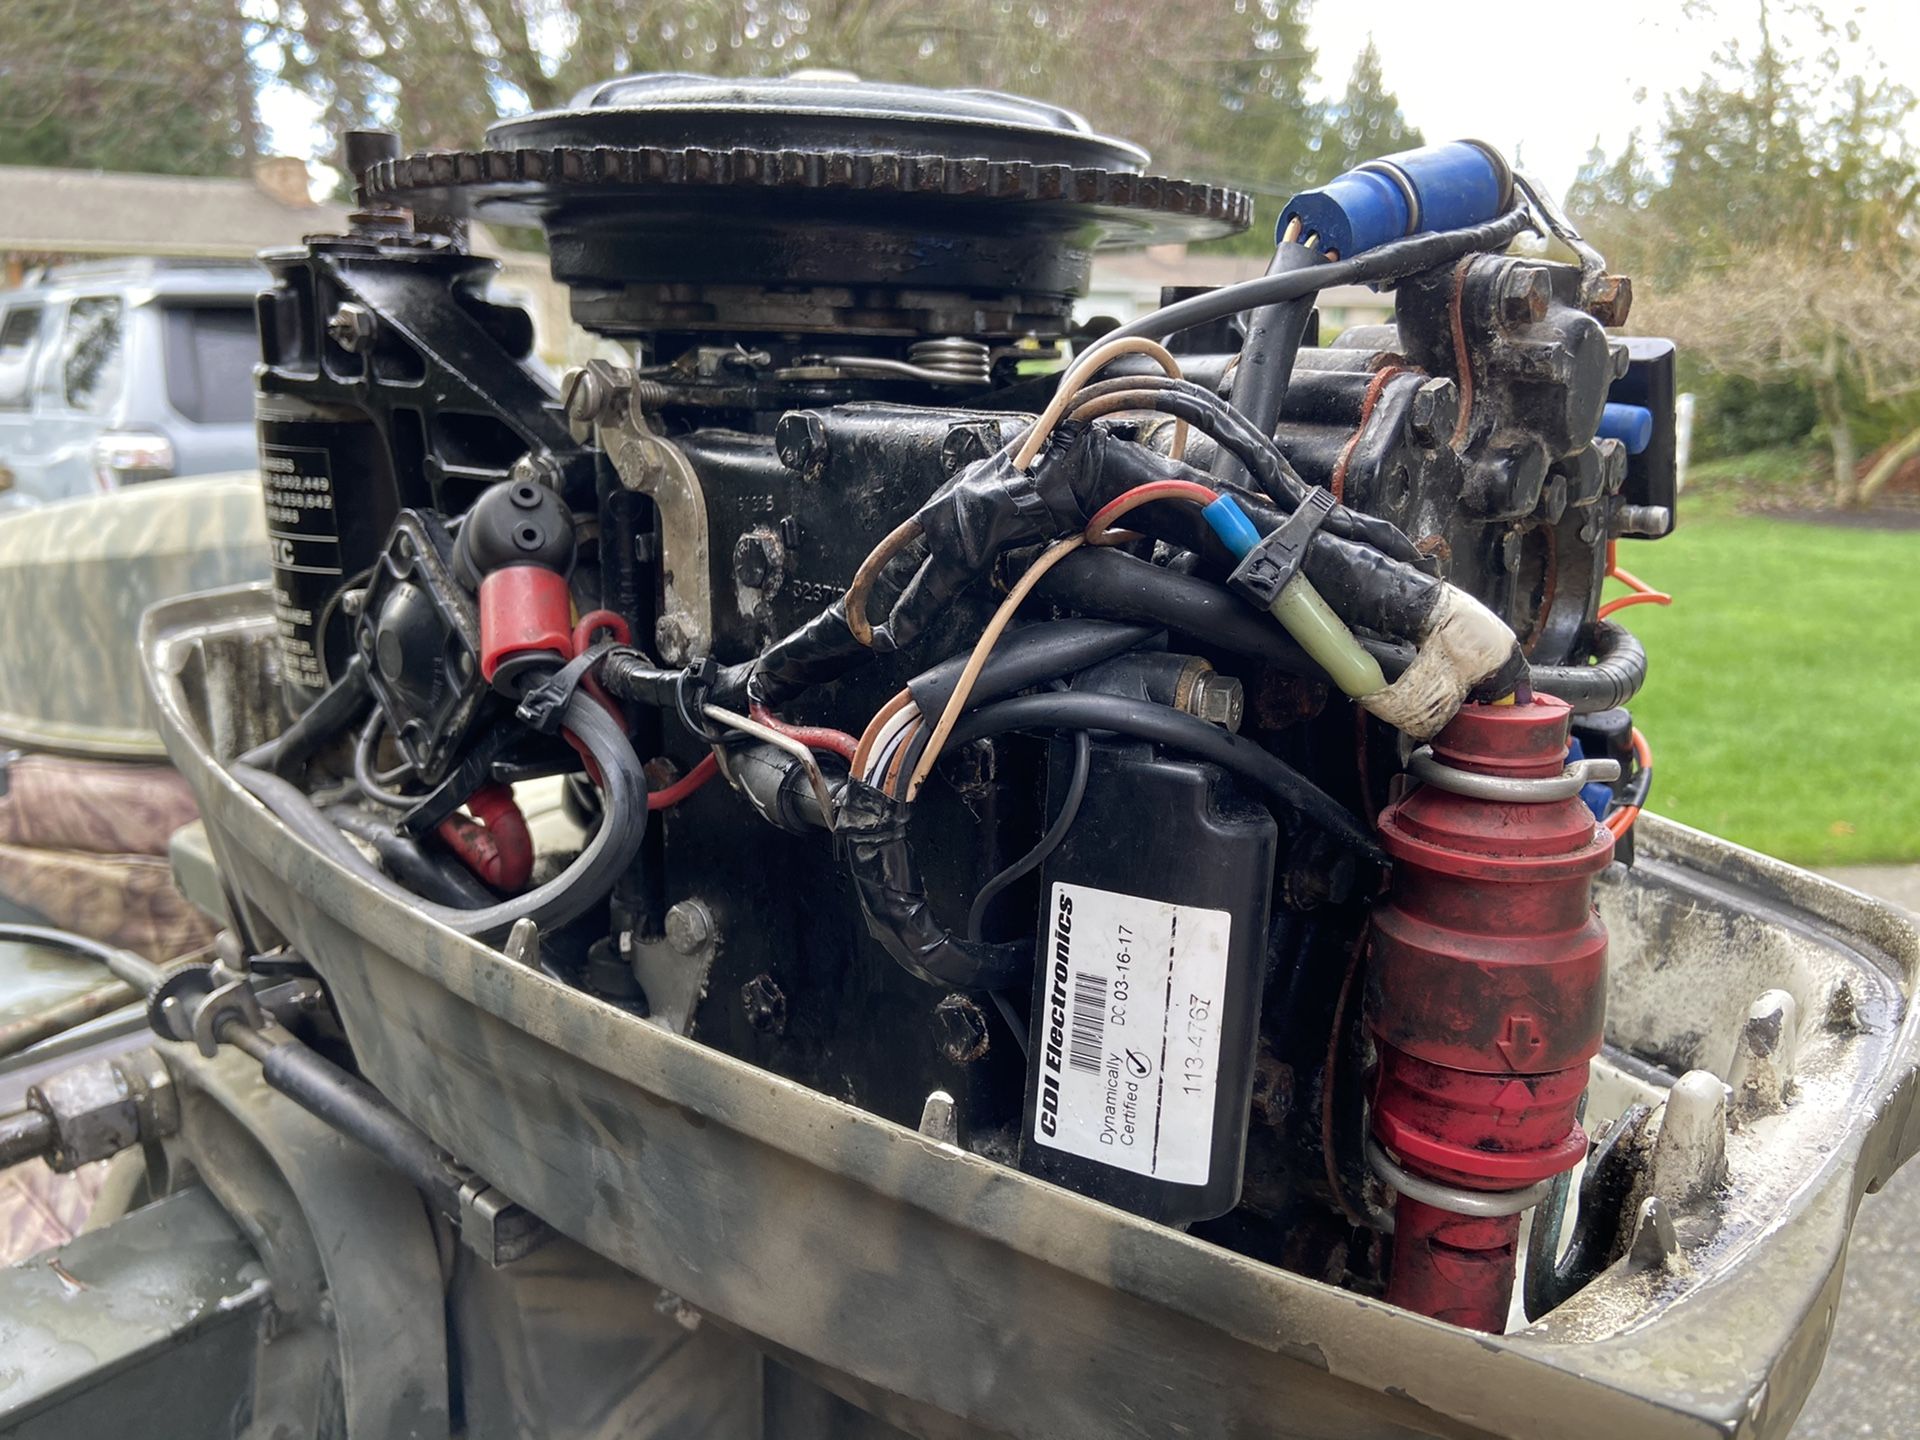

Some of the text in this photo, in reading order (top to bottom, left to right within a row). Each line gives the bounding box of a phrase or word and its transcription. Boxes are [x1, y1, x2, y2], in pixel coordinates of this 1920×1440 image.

[1113, 924, 1133, 1001] 03-16-17
[1040, 893, 1073, 1138] CDI Electronics
[1183, 993, 1211, 1095] 113-4767
[1100, 1052, 1123, 1146] Dynamically
[1120, 1082, 1139, 1147] Certified
